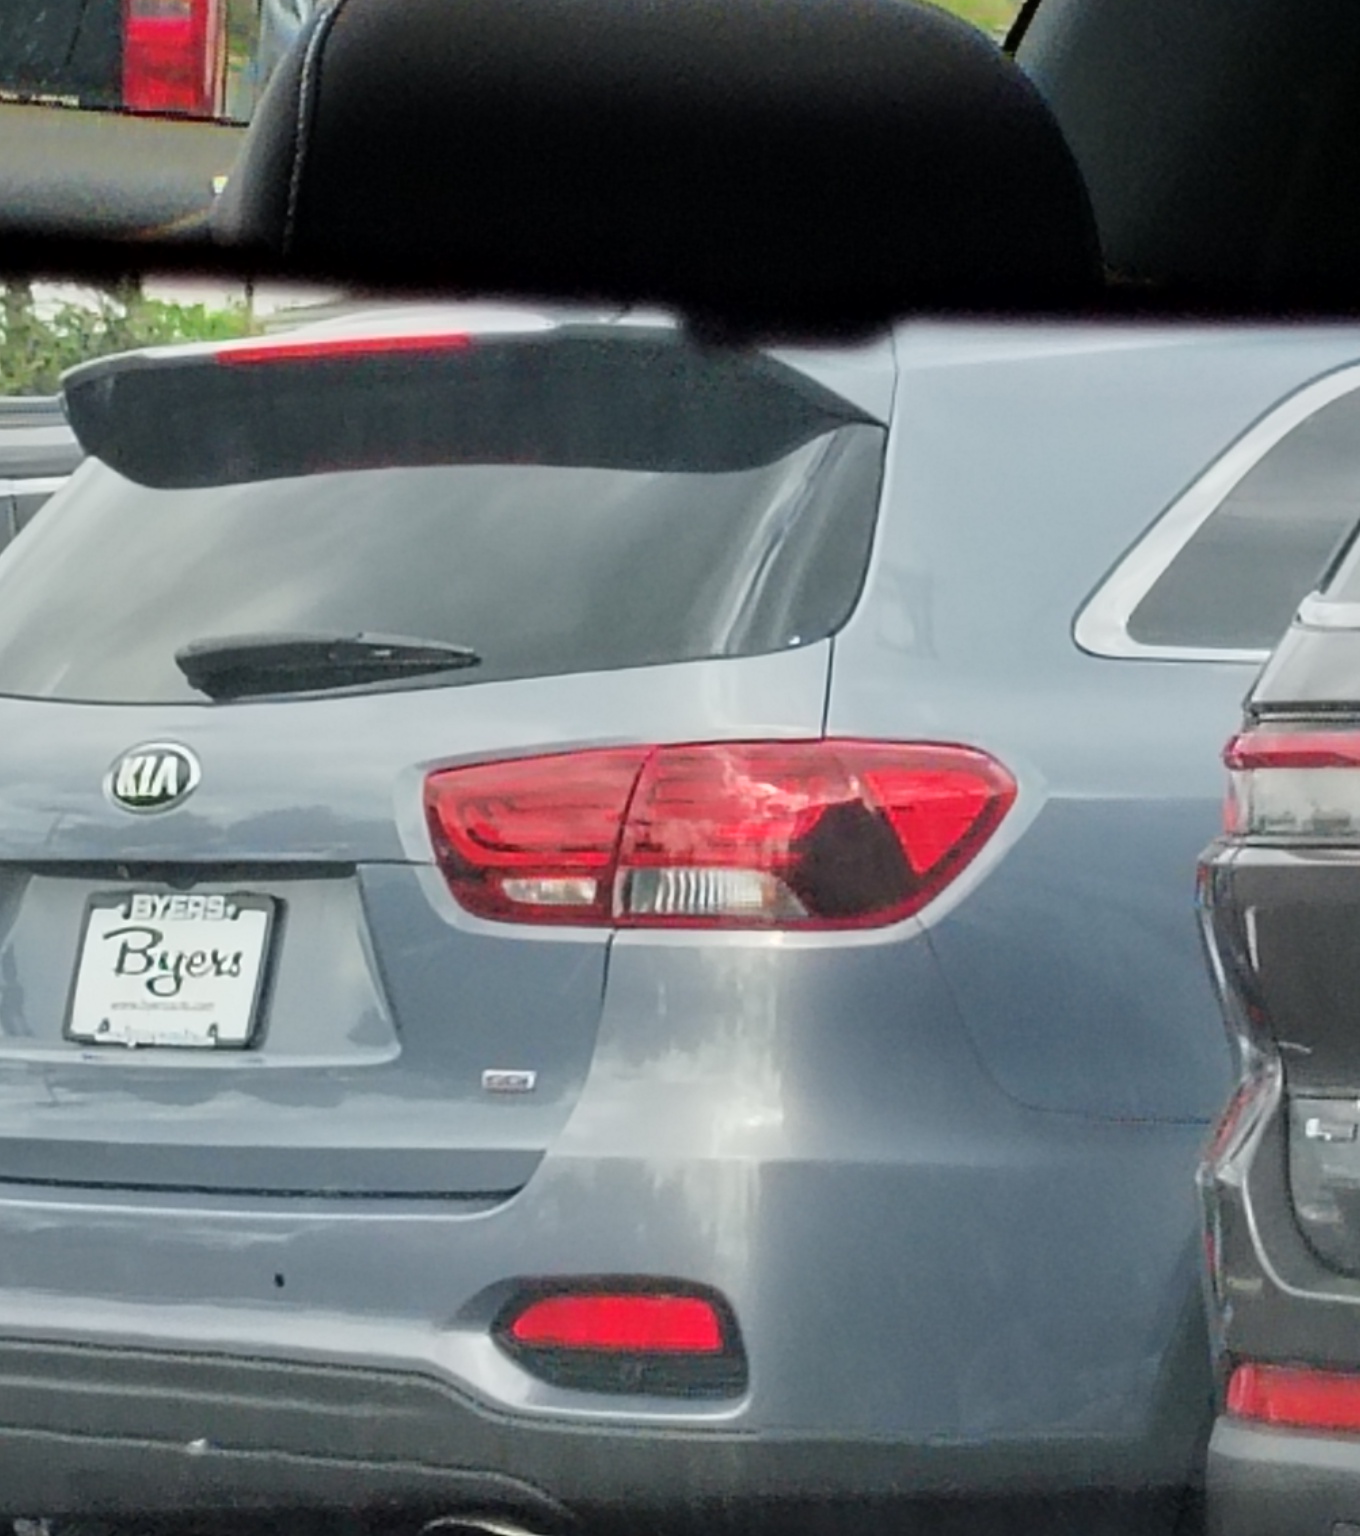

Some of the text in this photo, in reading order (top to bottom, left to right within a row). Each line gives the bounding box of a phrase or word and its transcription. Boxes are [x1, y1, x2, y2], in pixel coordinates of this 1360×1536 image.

[116, 755, 179, 797] KIA
[130, 894, 225, 921] BYERS
[103, 926, 242, 997] Byers
